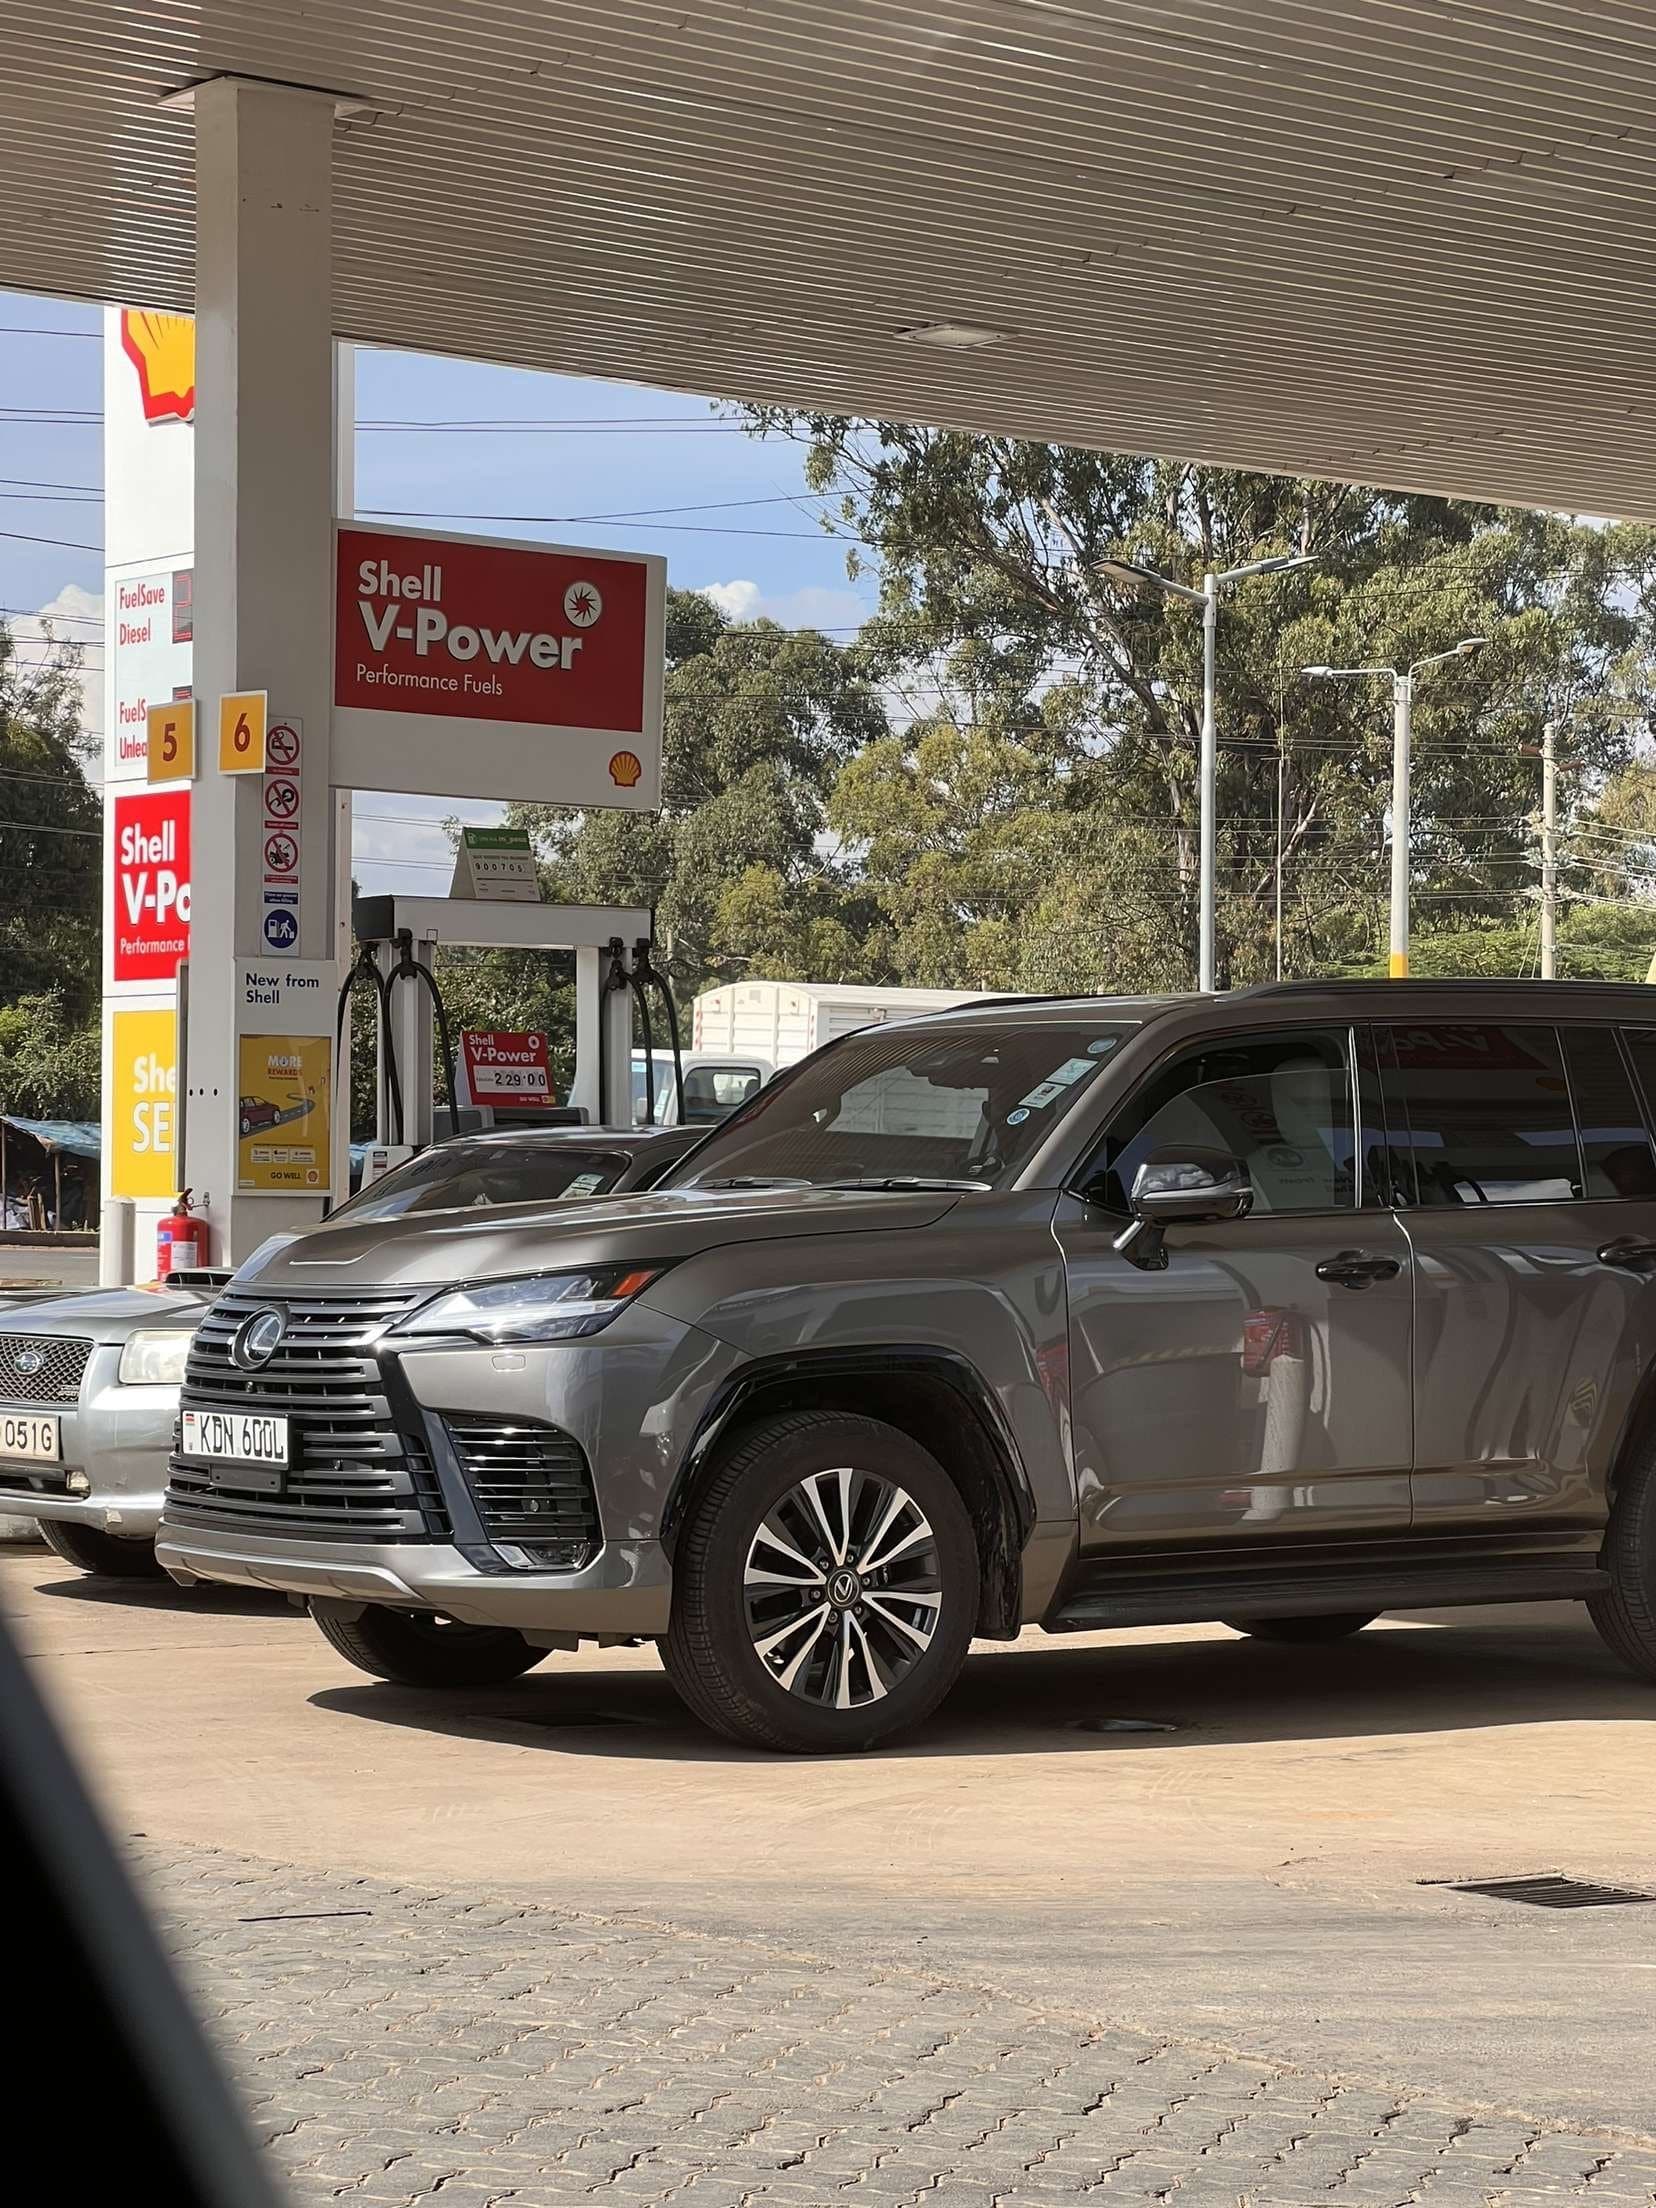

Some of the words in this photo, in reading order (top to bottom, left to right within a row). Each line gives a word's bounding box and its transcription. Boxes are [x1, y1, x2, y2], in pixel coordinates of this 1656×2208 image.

[119, 582, 165, 610] FuelSave
[358, 560, 442, 601] Shell
[119, 617, 151, 646] Diesel
[358, 600, 583, 671] V-Power
[357, 663, 458, 692] Performance
[464, 674, 503, 696] Fuels
[120, 698, 146, 724] FuelS
[120, 735, 147, 760] Unlea
[162, 722, 177, 763] 5
[234, 712, 250, 753] 6
[121, 819, 176, 866] Shell
[122, 869, 191, 925] V-Po
[120, 936, 184, 955] Performance
[246, 972, 280, 987] New
[286, 974, 319, 988] from
[246, 989, 280, 1004] Shell
[469, 1034, 494, 1046] Shell
[471, 1047, 537, 1063] V-Power
[133, 1052, 176, 1093] She
[267, 1056, 303, 1067] MORE
[132, 1100, 176, 1152] SE
[271, 1172, 282, 1180] GO
[284, 1172, 301, 1180] WELL
[5, 1419, 52, 1452] 051G
[243, 1418, 284, 1460] 600L
